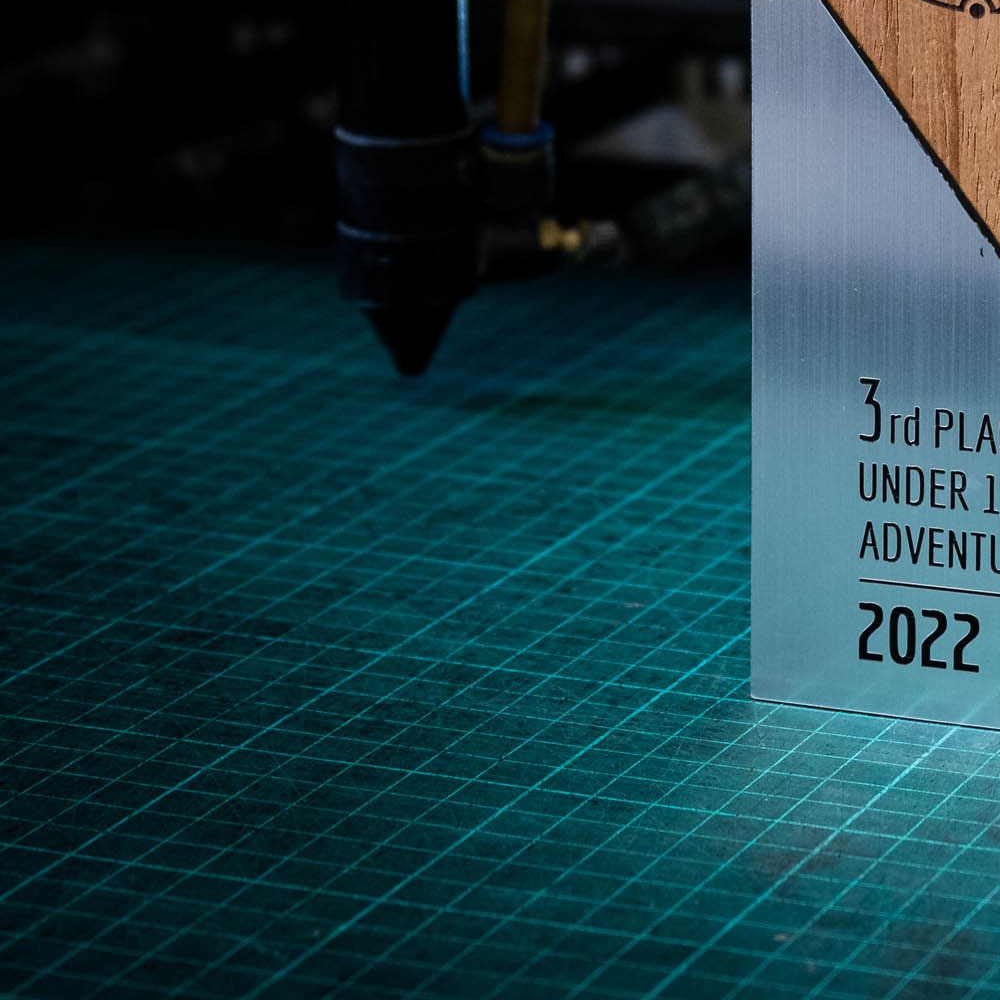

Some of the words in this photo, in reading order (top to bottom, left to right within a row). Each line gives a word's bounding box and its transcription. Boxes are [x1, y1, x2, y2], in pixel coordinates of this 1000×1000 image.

[859, 377, 920, 447] 3rd
[859, 460, 970, 512] UNDER
[858, 602, 980, 674] 2022
